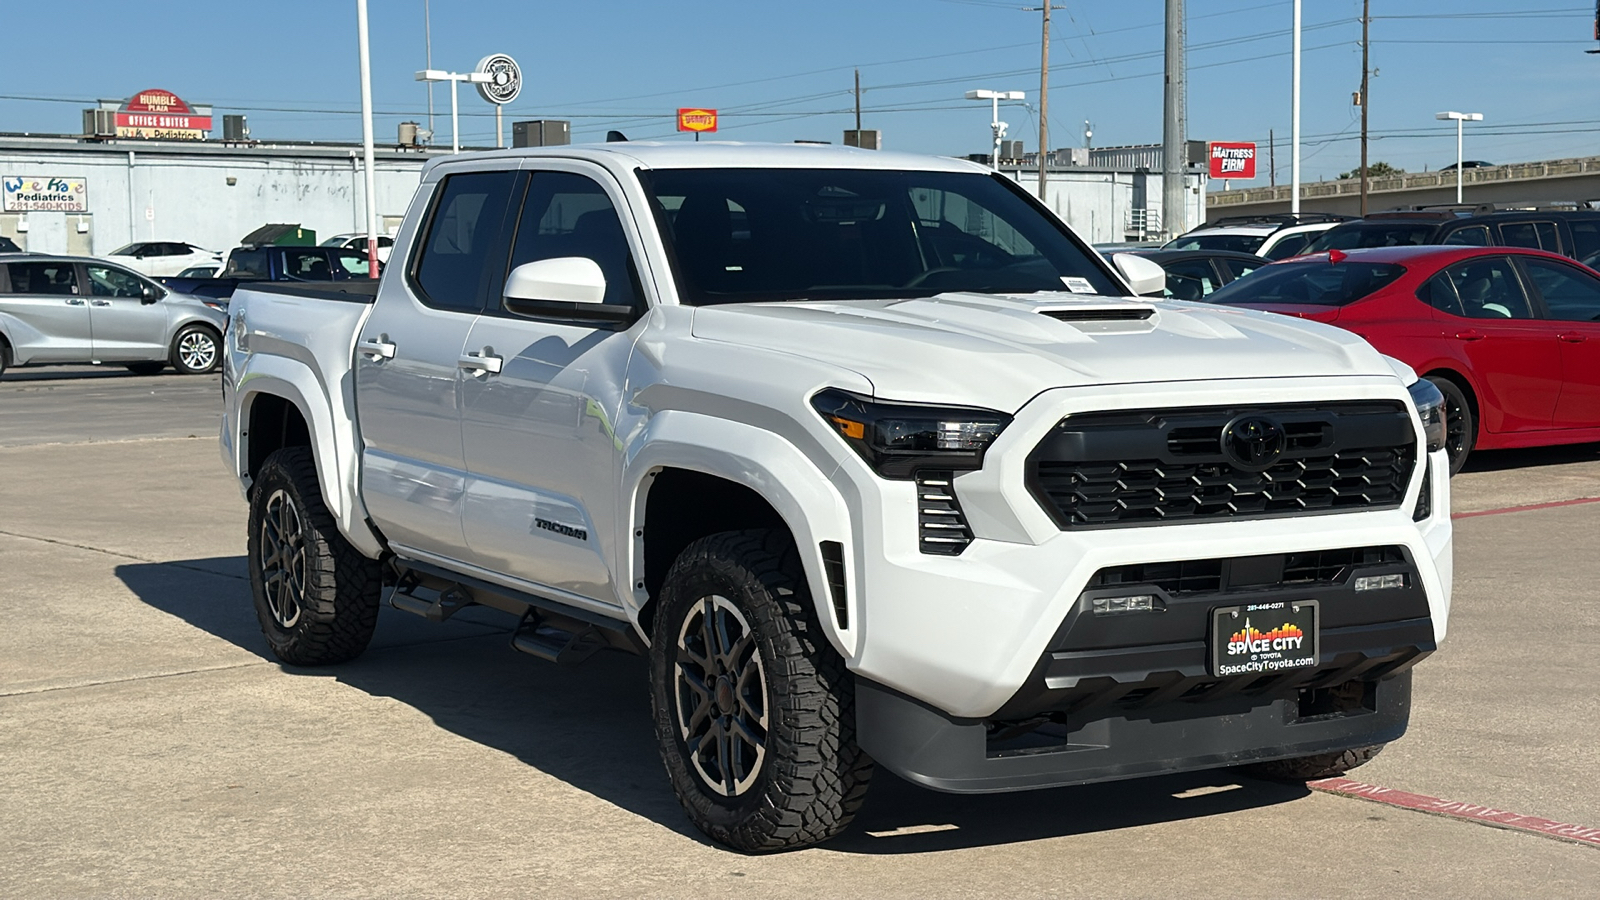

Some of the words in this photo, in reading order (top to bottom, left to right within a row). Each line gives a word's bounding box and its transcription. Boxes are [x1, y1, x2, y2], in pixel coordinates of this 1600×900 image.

[139, 94, 177, 106] HUMBLE
[147, 104, 169, 112] PLAZA
[128, 115, 157, 126] OFFICE
[159, 116, 189, 128] SUITES
[154, 129, 198, 139] Pediatrics
[1221, 158, 1246, 171] FIRM
[5, 176, 43, 193] Wee
[47, 177, 85, 194] Kare
[17, 192, 75, 202] Pediatrics
[10, 201, 83, 211] 281-540-KIDS
[535, 517, 588, 541] TACOMA
[1246, 602, 1285, 612] 281-446-0271
[1227, 630, 1270, 655] SPACE
[1272, 636, 1304, 651] CITY
[1259, 652, 1282, 660] TOYOTA
[1219, 657, 1314, 676] SpaceCityToyota.com
